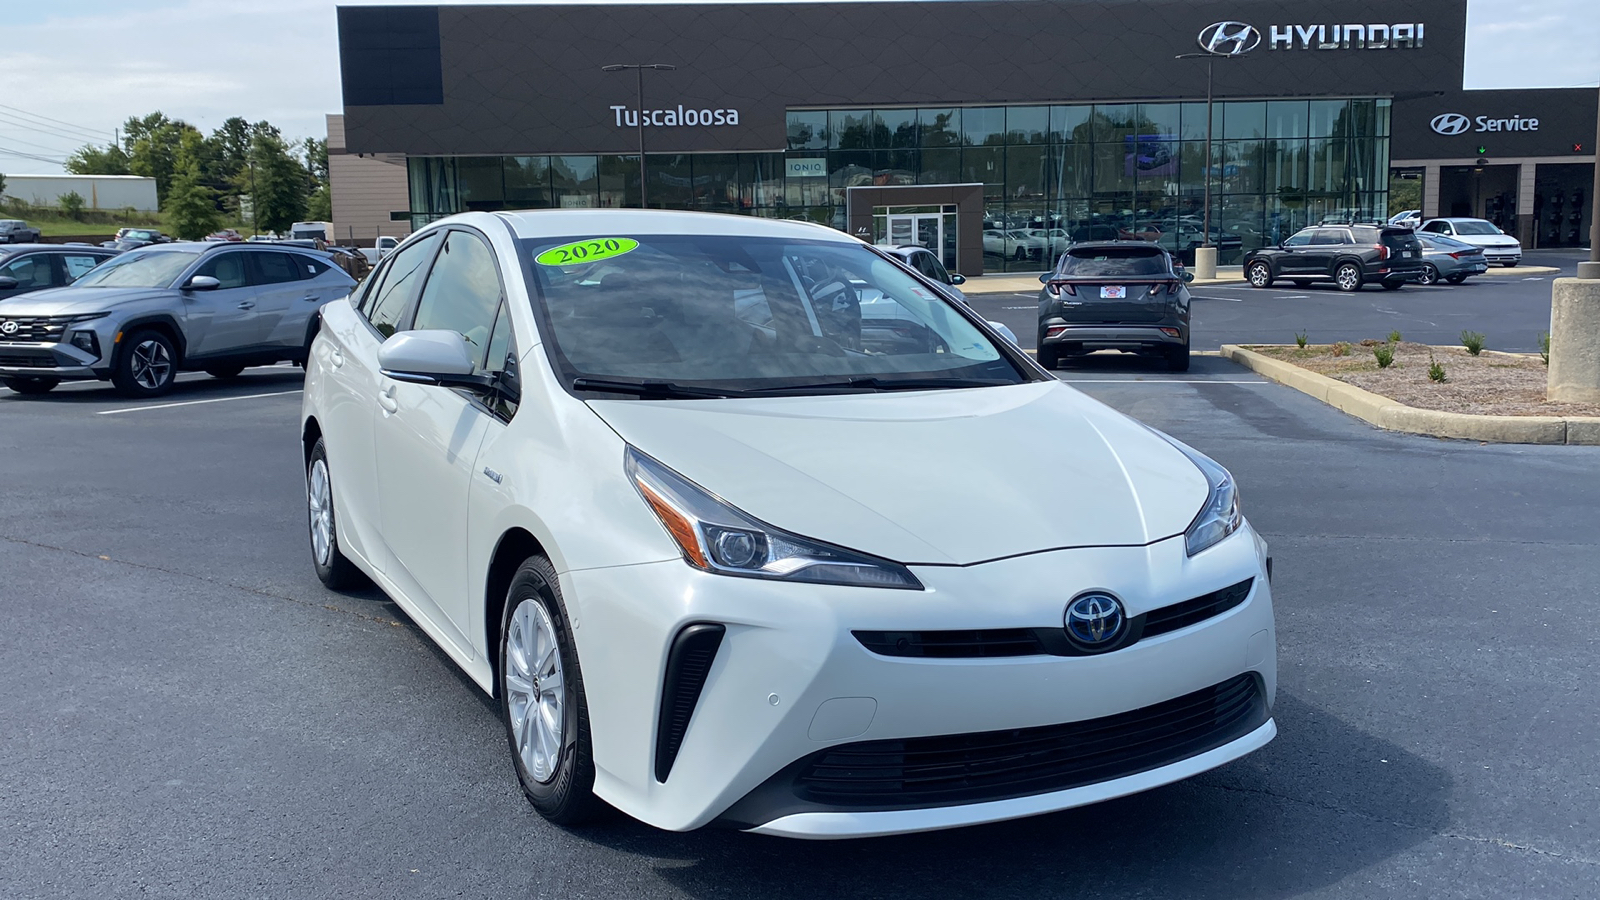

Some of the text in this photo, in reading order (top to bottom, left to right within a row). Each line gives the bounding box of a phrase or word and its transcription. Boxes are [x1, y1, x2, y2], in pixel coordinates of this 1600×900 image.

[1269, 23, 1424, 50] HYUNDAI
[609, 104, 739, 127] Tuscaloosa
[1475, 114, 1539, 132] Service
[790, 163, 822, 171] IONIQ
[555, 239, 620, 263] 2020
